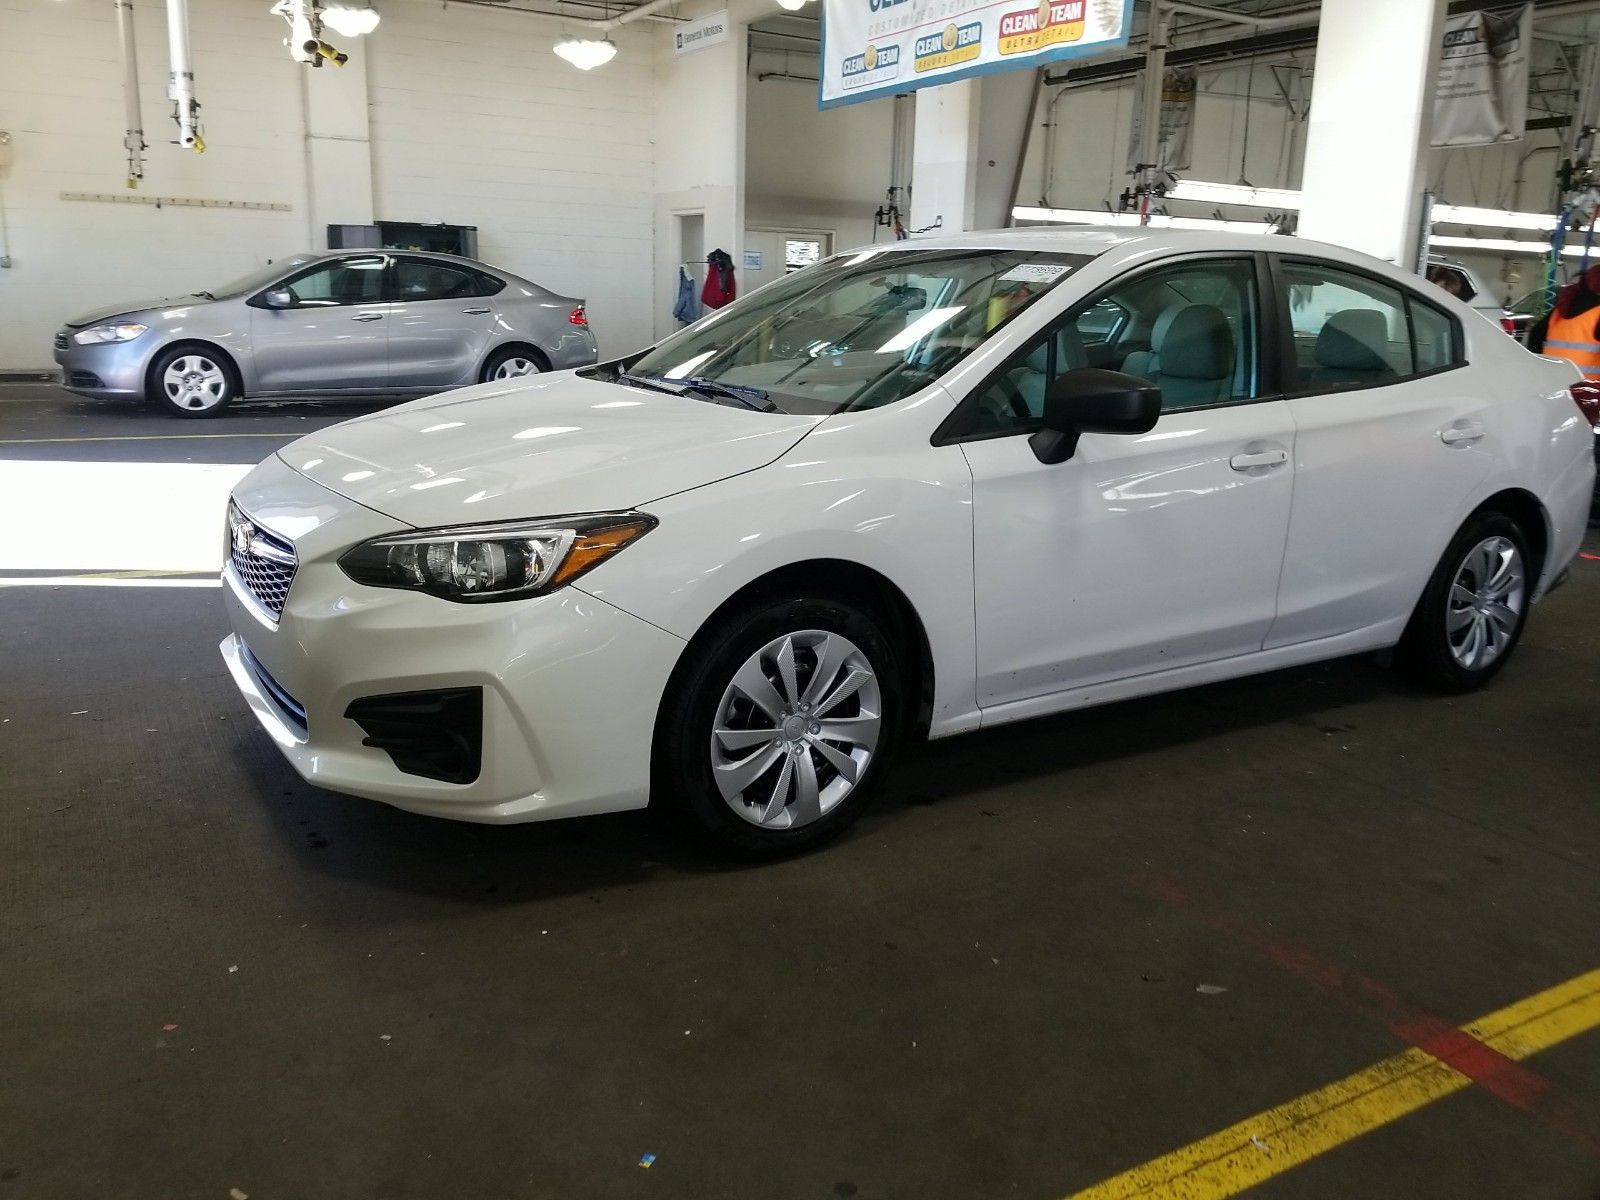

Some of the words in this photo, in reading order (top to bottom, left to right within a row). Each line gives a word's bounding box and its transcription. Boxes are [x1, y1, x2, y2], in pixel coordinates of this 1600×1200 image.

[1002, 13, 1037, 35] CLEAN
[1051, 2, 1082, 23] TEAM
[684, 30, 702, 43] General
[703, 25, 723, 37] Motors
[917, 36, 941, 56] CLEAN
[959, 25, 980, 45] TEAM
[1446, 30, 1475, 44] CLEAN
[844, 54, 864, 75] CLEAN
[878, 48, 898, 67] TEAM
